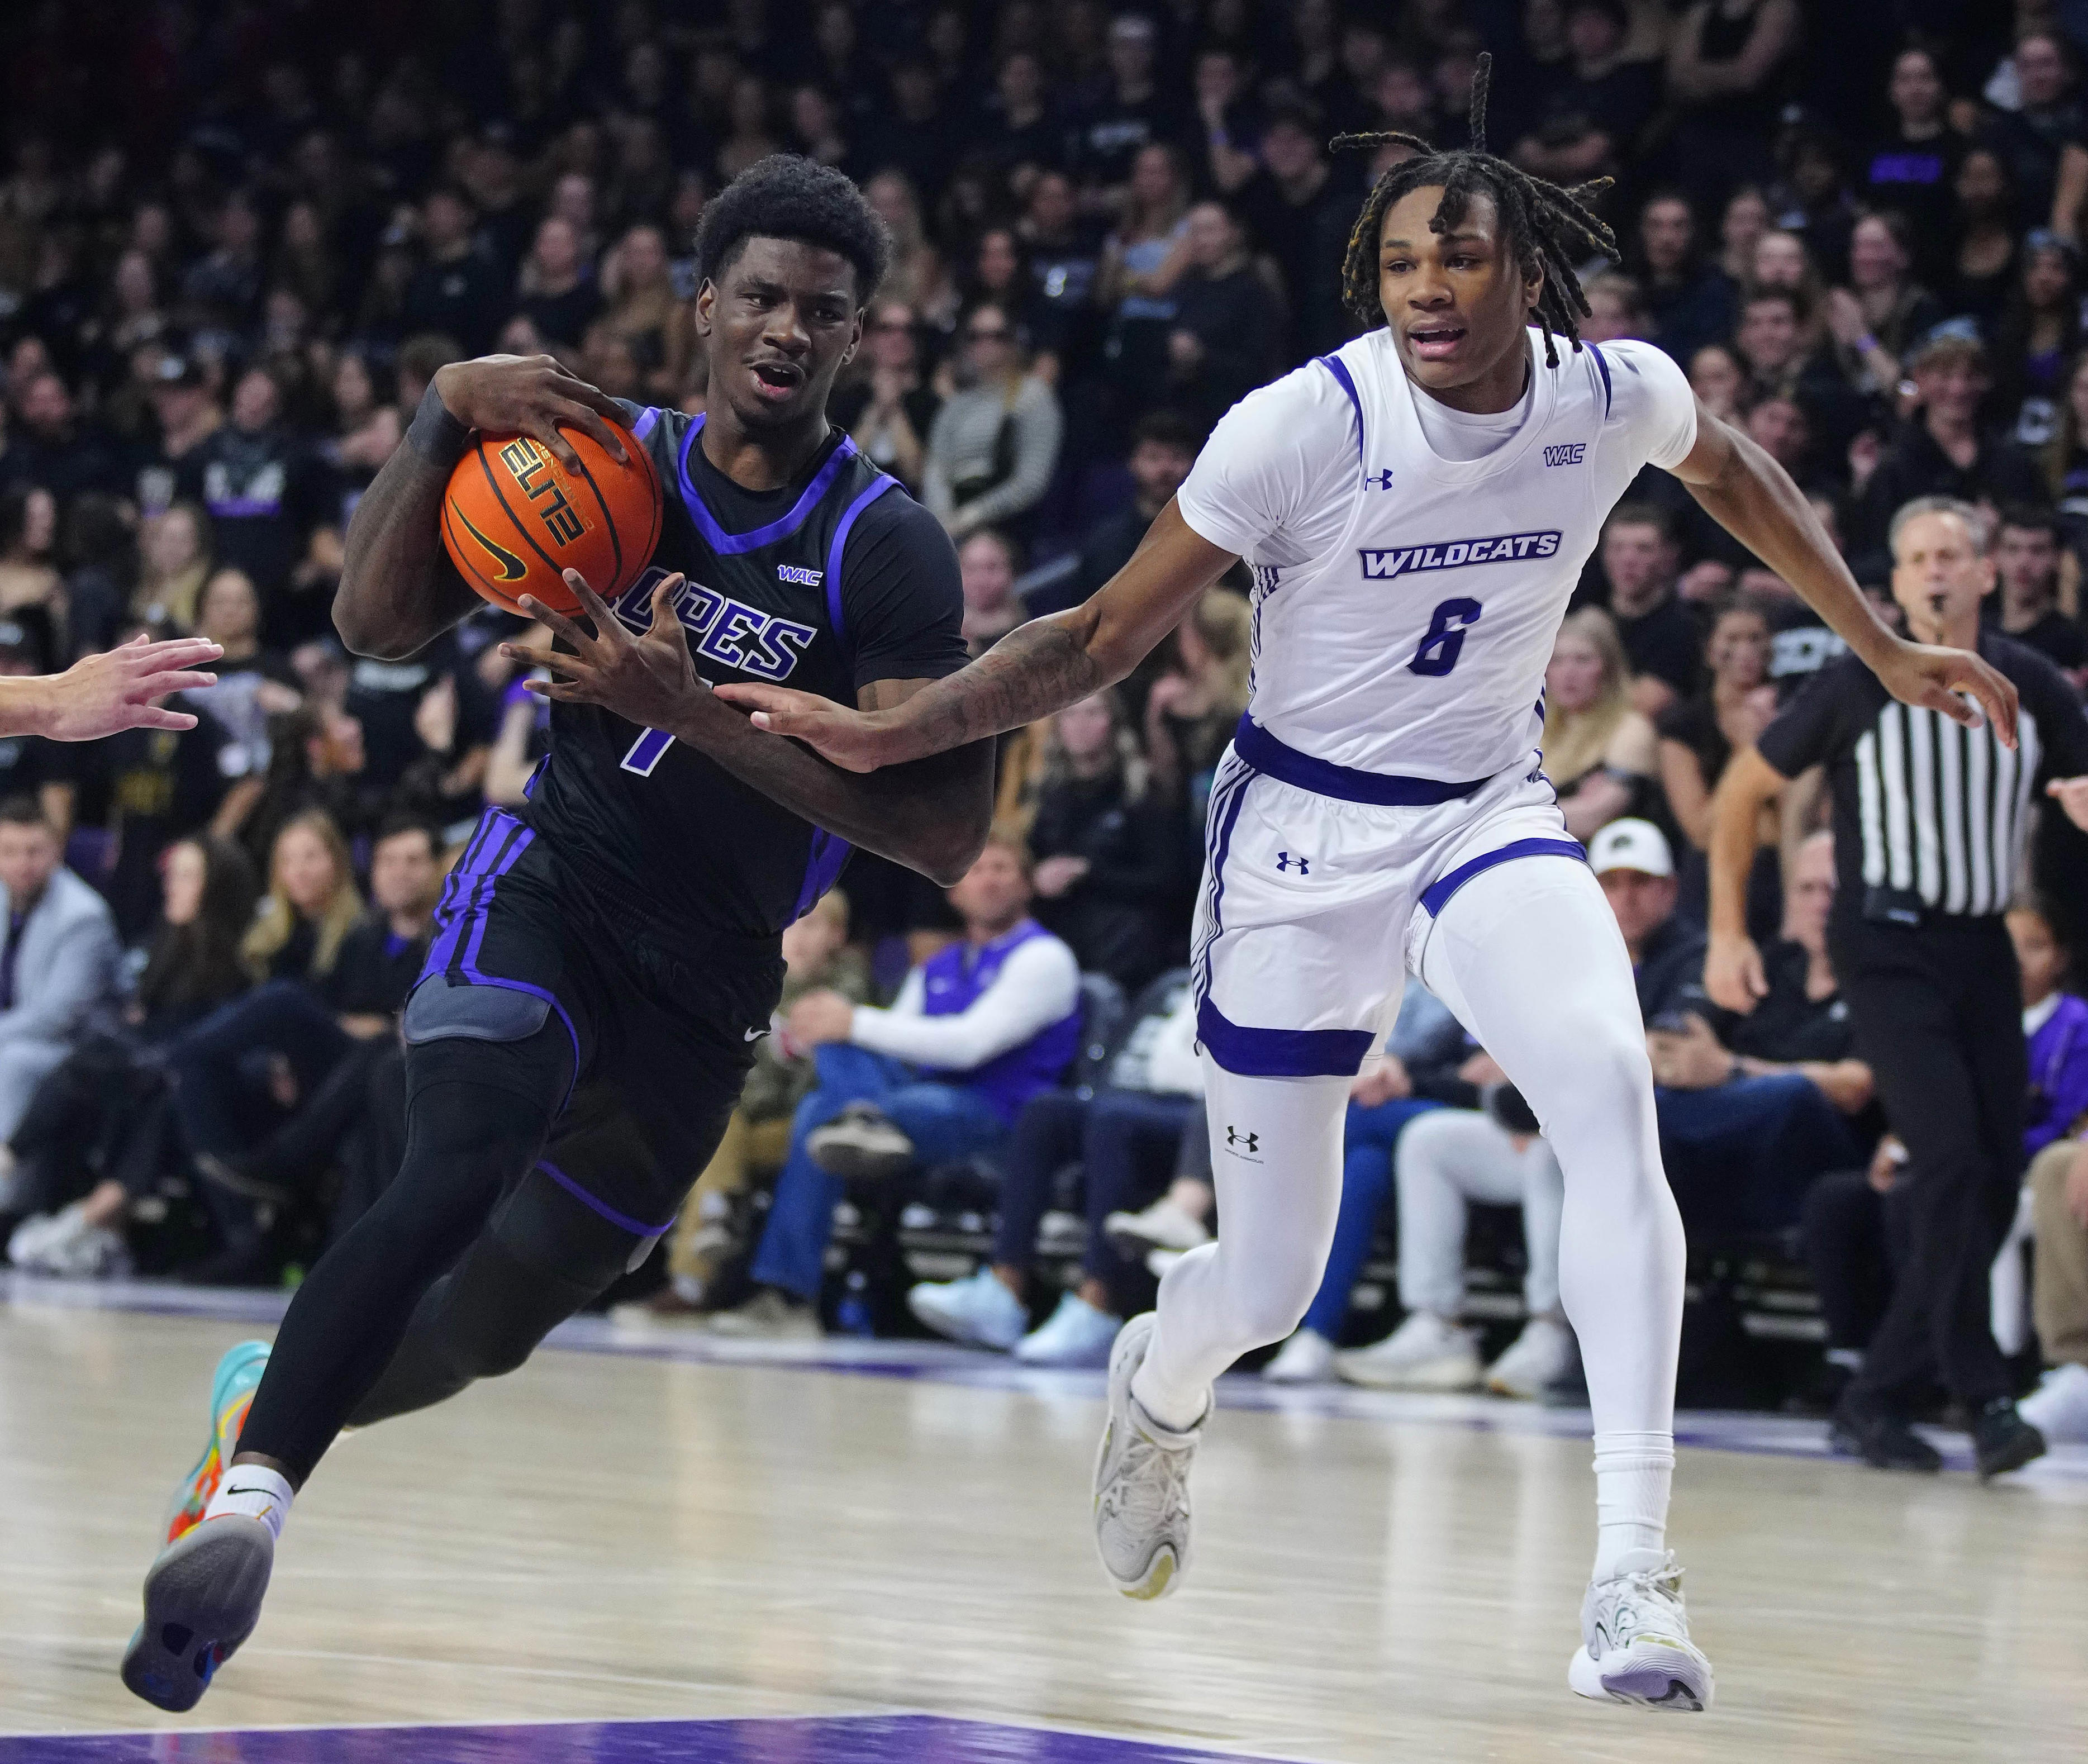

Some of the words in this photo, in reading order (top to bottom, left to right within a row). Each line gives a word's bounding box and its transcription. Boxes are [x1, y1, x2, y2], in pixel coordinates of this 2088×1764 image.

[1543, 443, 1586, 467] WAC
[777, 564, 824, 587] WAC
[1362, 533, 1559, 578] WILDCATS
[610, 565, 818, 681] OPES
[1405, 596, 1483, 678] 6
